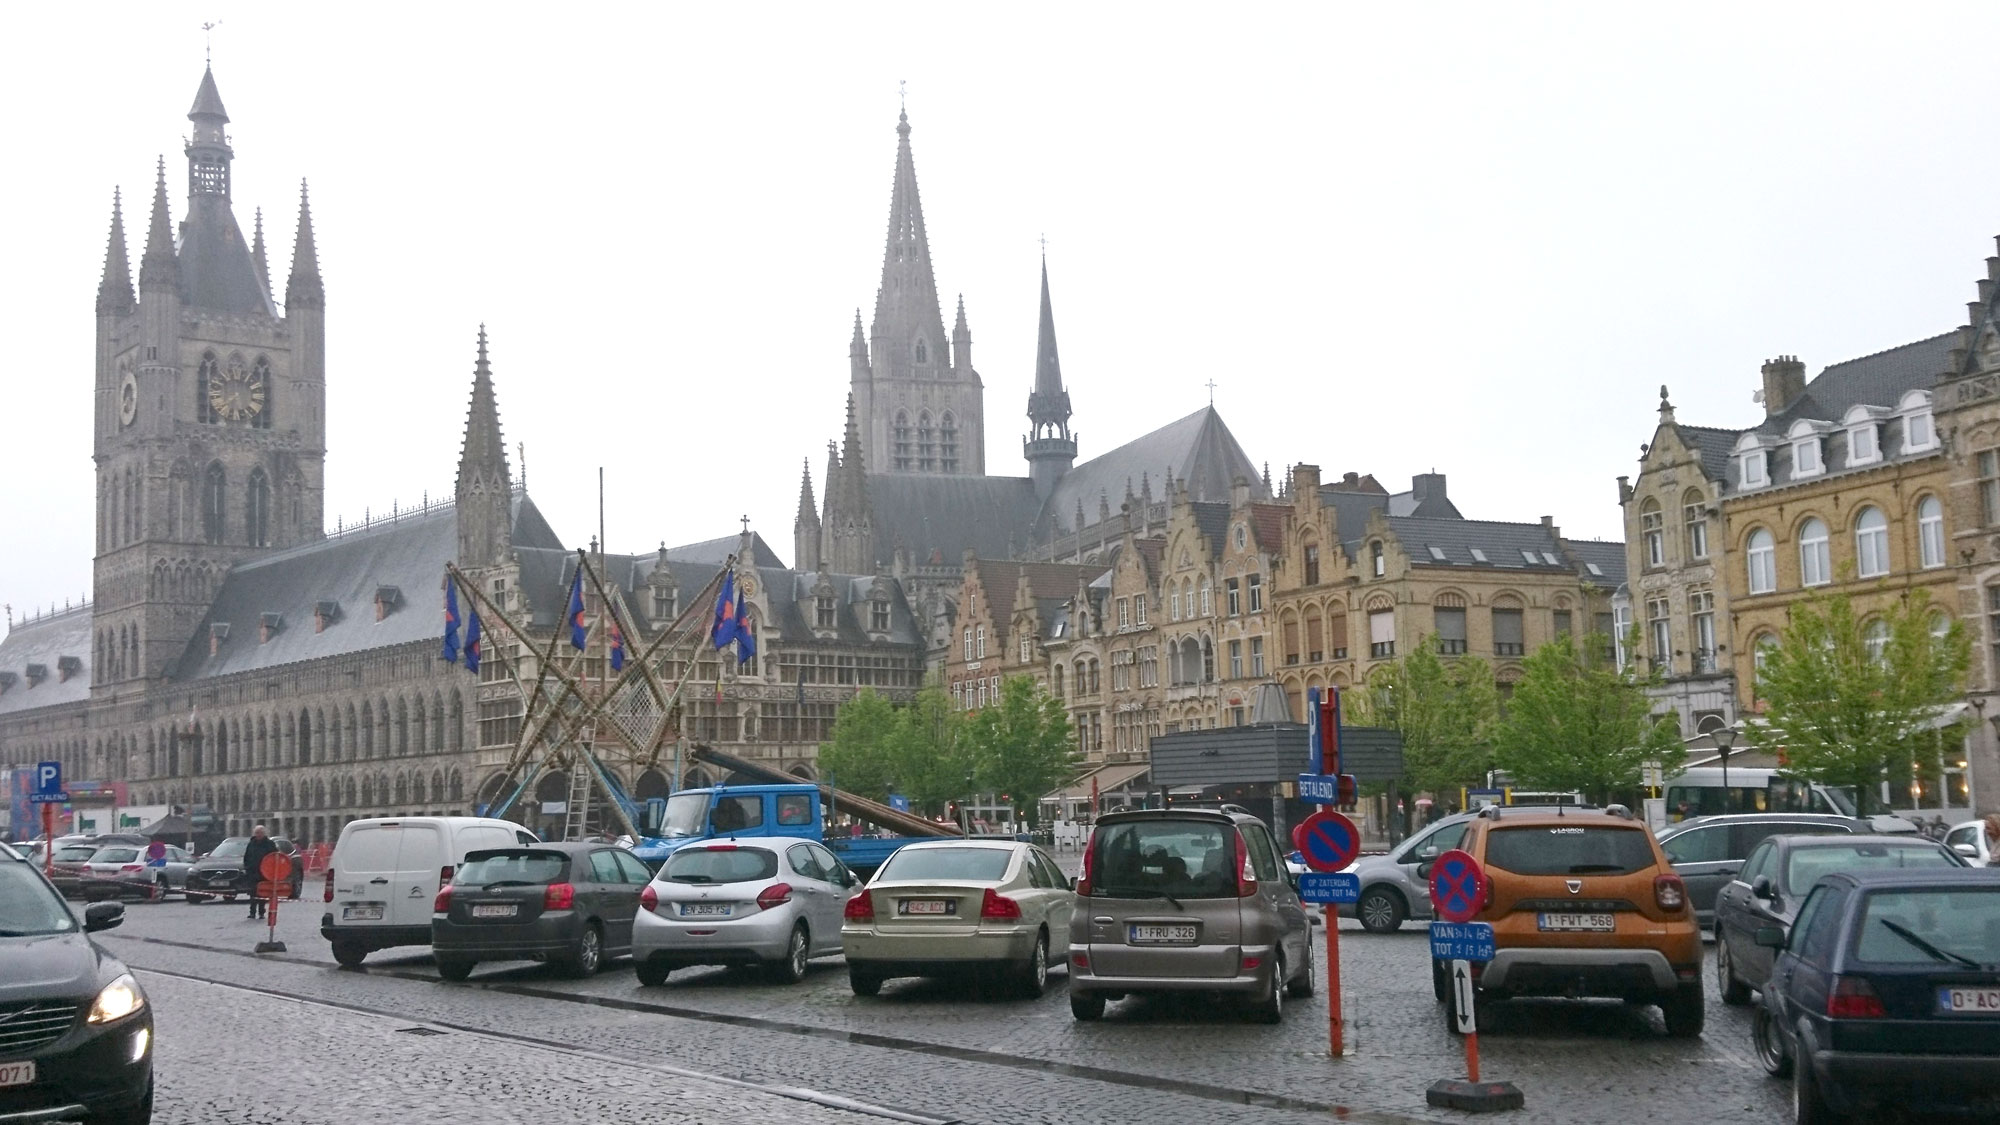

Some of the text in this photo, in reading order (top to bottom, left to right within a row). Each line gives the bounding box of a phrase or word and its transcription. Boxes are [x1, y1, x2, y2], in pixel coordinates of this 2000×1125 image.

[1309, 701, 1317, 760] P
[41, 766, 57, 788] P
[1300, 781, 1334, 798] BETALEND
[1308, 878, 1350, 887] OP ZATERDAG
[1303, 889, 1316, 897] VAN
[1332, 889, 1344, 897] TOT
[1138, 927, 1195, 938] 1-FRU-326
[1433, 926, 1454, 939] VAN
[1434, 943, 1453, 955] TOT
